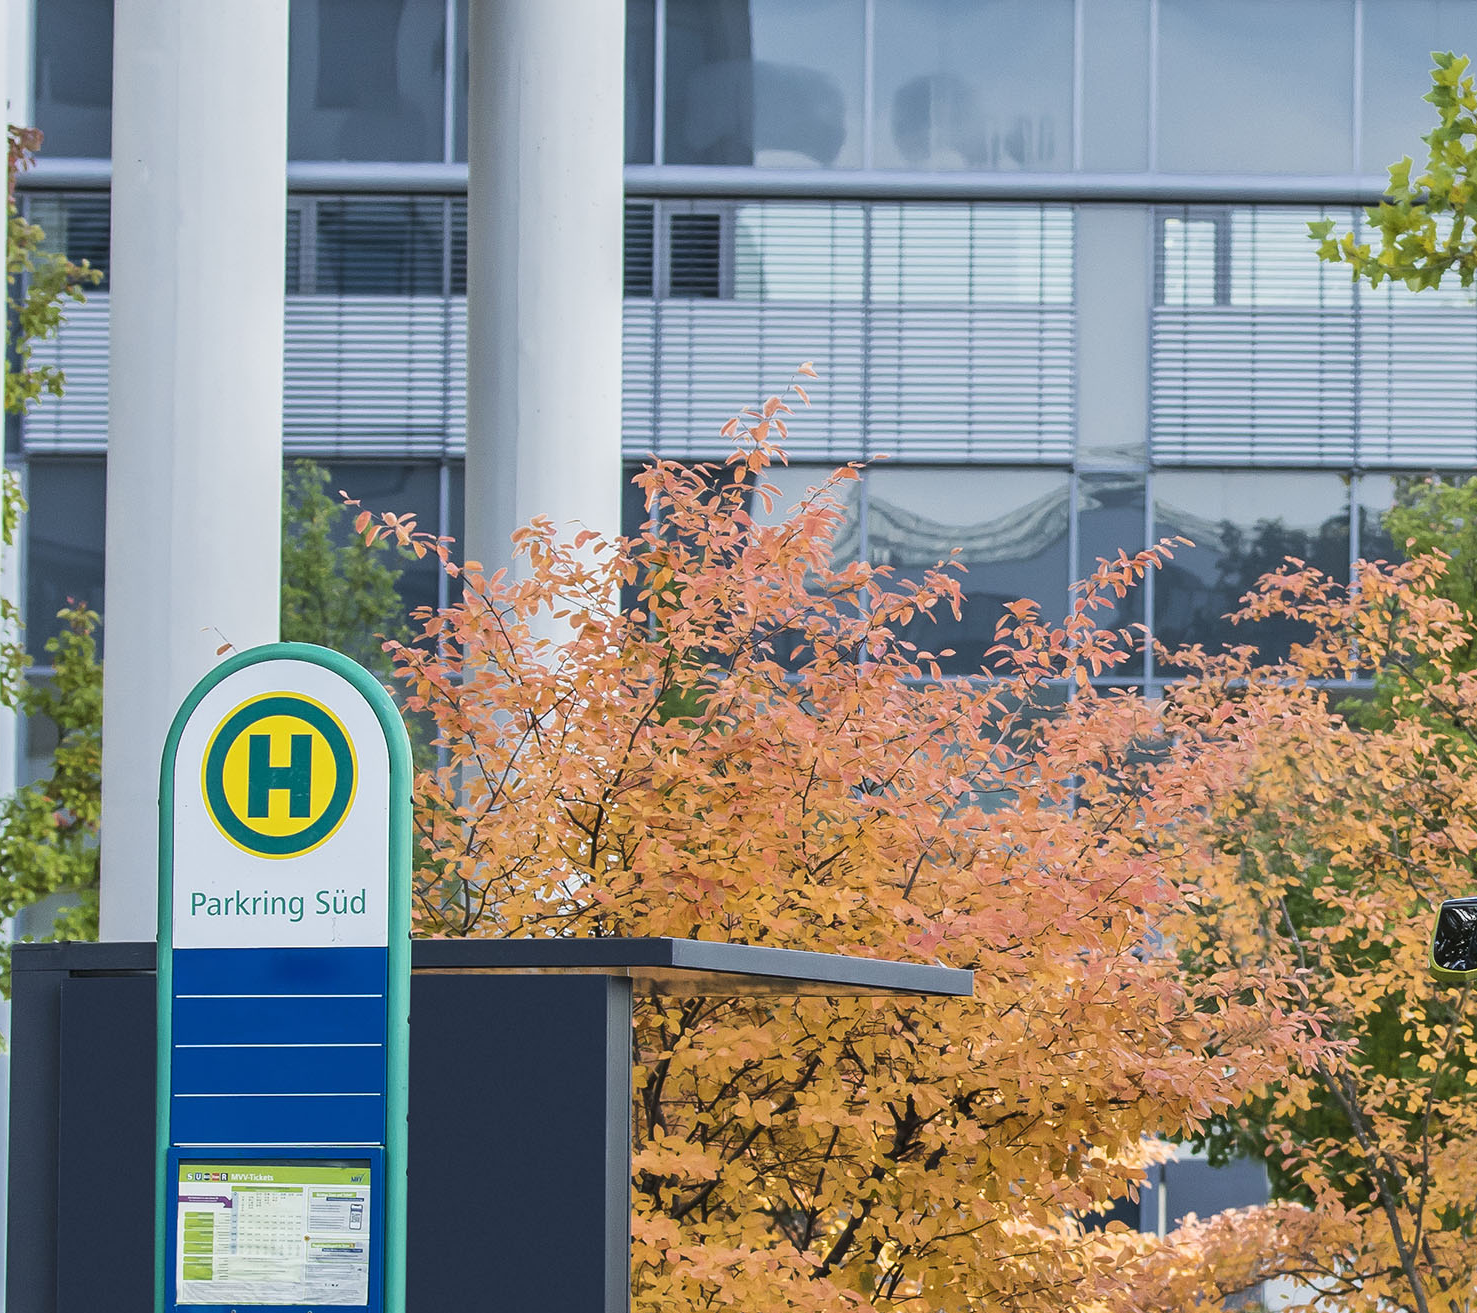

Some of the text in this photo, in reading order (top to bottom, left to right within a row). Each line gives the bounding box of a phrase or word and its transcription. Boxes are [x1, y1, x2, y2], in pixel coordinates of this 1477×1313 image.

[247, 733, 313, 819] H
[190, 888, 367, 922] Parkring Süd
[230, 1173, 274, 1181] MVV-Tickets
